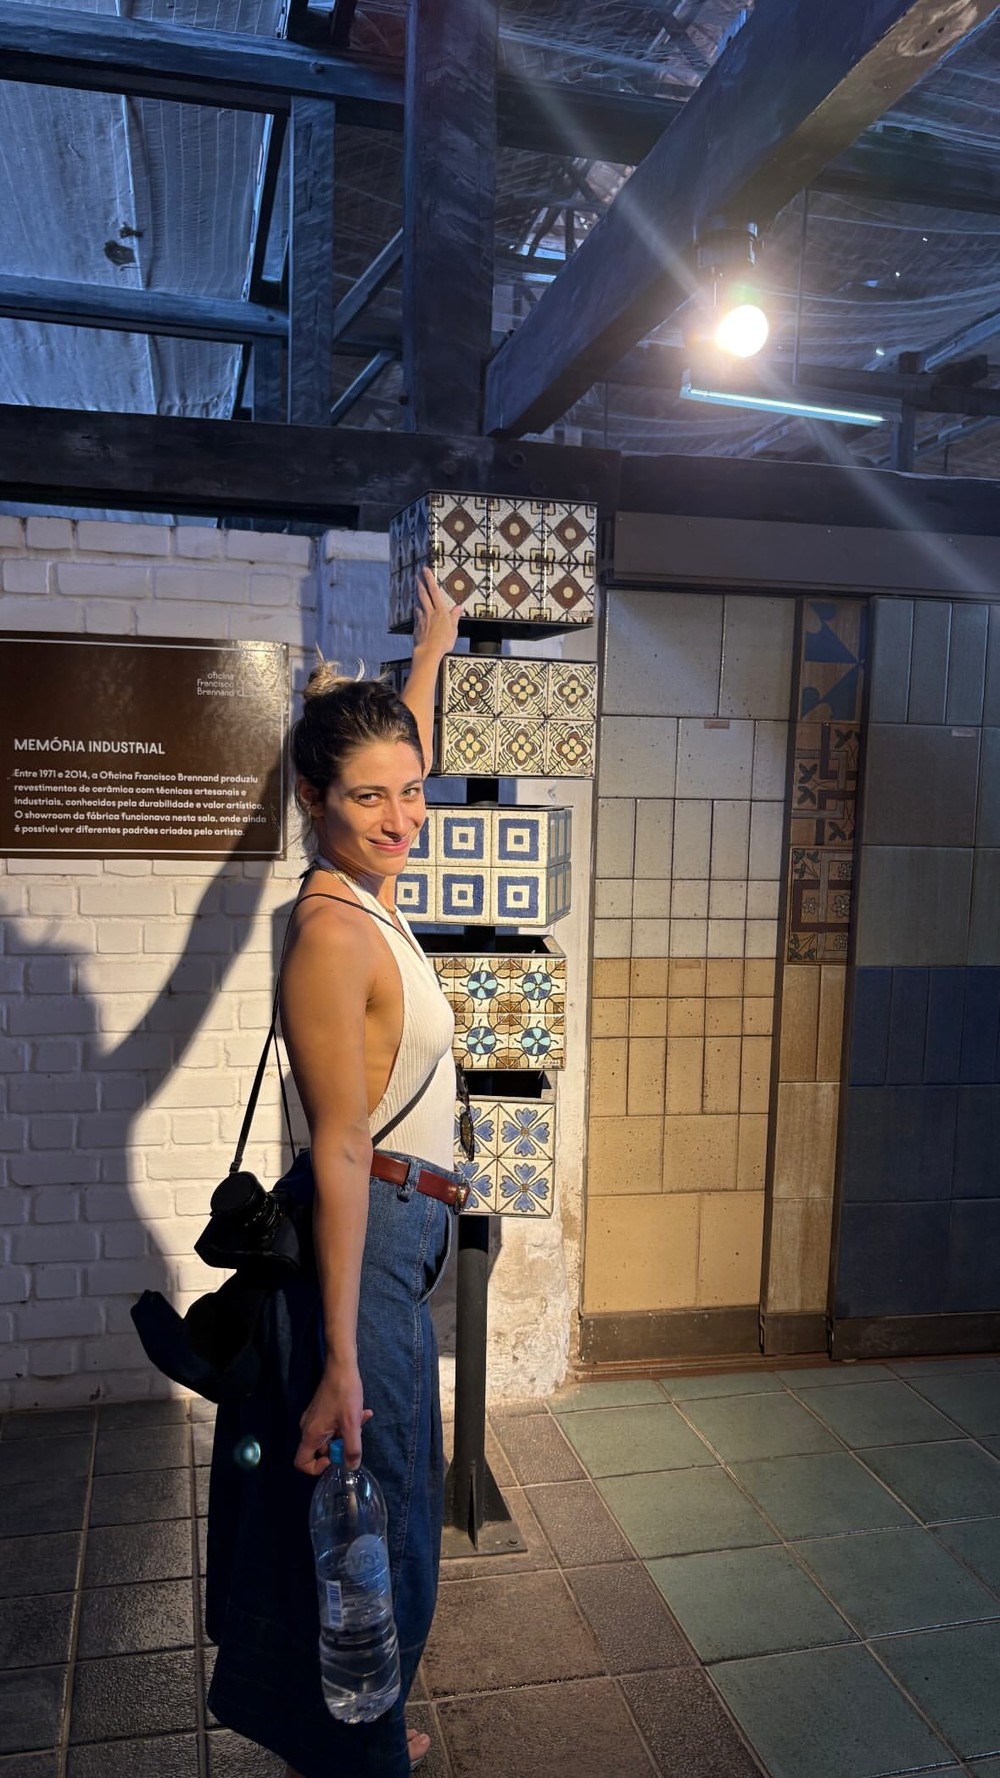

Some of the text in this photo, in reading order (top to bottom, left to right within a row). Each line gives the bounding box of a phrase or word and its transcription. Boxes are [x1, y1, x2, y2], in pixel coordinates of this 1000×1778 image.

[196, 678, 234, 688] Francisco
[196, 687, 234, 696] Brennand
[14, 736, 166, 754] MEMÓRIA INDUSTRIAL
[14, 768, 38, 778] Entre
[39, 770, 56, 778] 1971
[64, 770, 90, 780] 2014,
[100, 771, 132, 780] Oficina
[134, 772, 176, 781] Francisco
[178, 773, 219, 782] Brennand
[221, 775, 258, 784] produziu
[14, 784, 77, 792] revestimentos
[79, 784, 90, 793] de
[92, 785, 134, 794] cerâmica
[156, 787, 193, 795] técnicas
[194, 788, 239, 796] artesanais
[14, 797, 64, 806] industriais,
[65, 798, 116, 807] conhecidos
[118, 798, 137, 808] pela
[138, 799, 194, 808] durabilidade
[226, 801, 264, 810] artístico.
[14, 810, 23, 819] O
[24, 810, 71, 819] showroom
[73, 812, 84, 820] da
[86, 812, 120, 820] fábrica
[121, 812, 170, 821] funcionava
[197, 814, 218, 823] sala,
[220, 814, 240, 822] onde
[242, 815, 266, 823] ainda
[14, 825, 20, 833] é
[22, 825, 58, 835] possível
[76, 825, 120, 834] diferentes
[122, 826, 158, 836] padrões
[160, 826, 192, 835] criados
[194, 827, 213, 837] pelo
[214, 828, 245, 836] artista.
